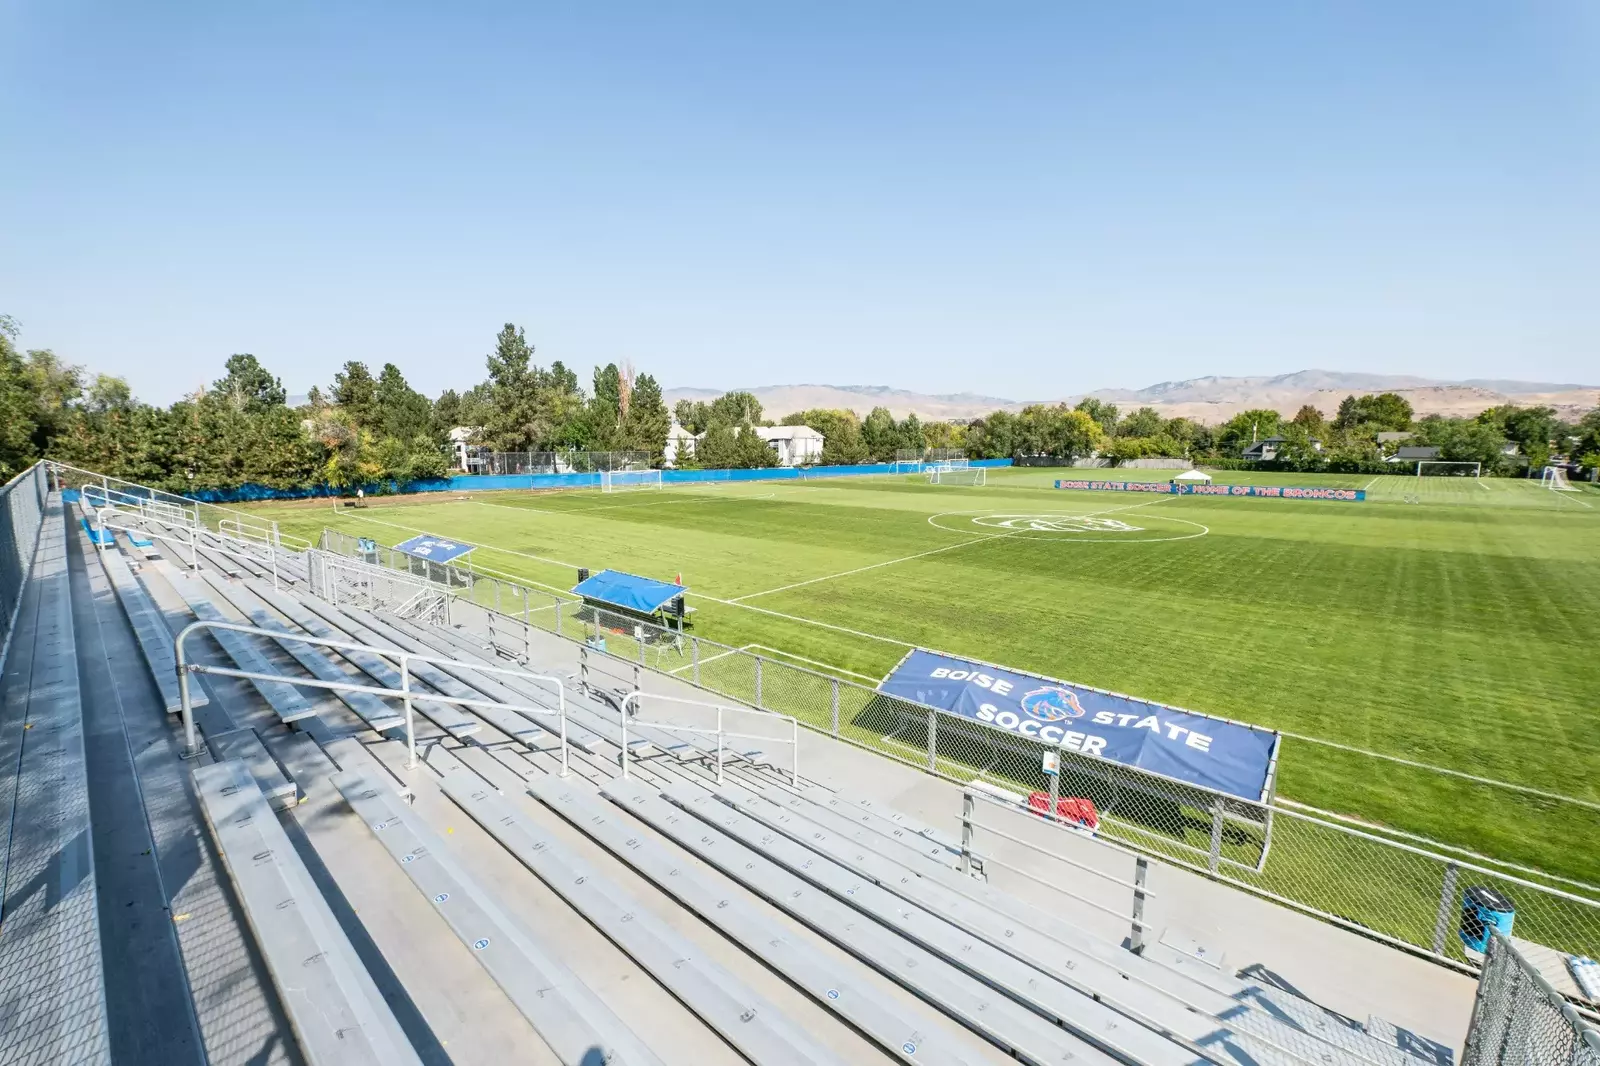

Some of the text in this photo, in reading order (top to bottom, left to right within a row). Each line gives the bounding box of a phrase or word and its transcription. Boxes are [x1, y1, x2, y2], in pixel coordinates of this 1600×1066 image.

[1091, 481, 1125, 490] STATE
[1126, 482, 1172, 492] SOCCER
[1192, 484, 1230, 494] HOME
[1231, 486, 1251, 495] OF
[1254, 487, 1280, 497] THE
[1283, 488, 1357, 500] BRONCOS
[930, 668, 1214, 753] BOISE STATE
[975, 703, 1108, 755] SOCCER
